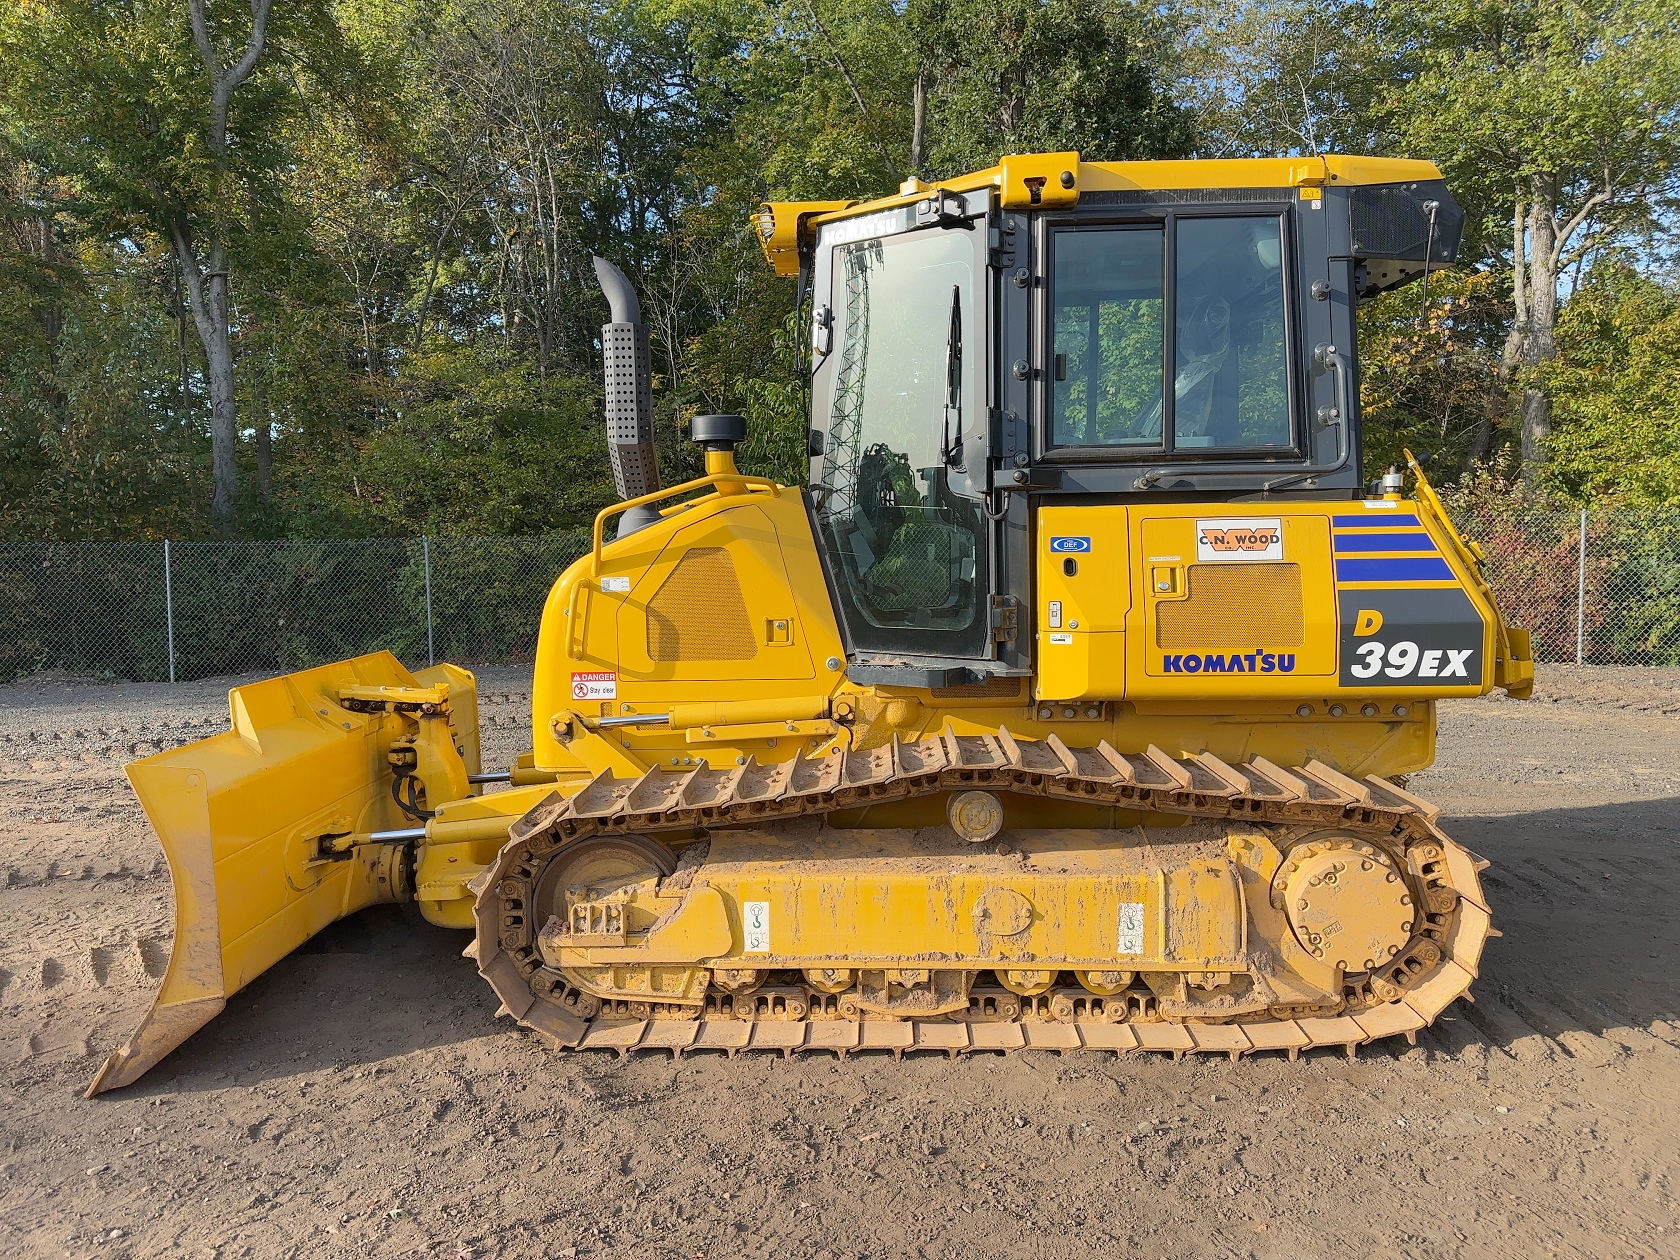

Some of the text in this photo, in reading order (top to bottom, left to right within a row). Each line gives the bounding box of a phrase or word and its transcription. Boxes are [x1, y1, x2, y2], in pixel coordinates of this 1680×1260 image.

[824, 217, 897, 246] KOMATSU
[1199, 534, 1280, 545] C.N. WOOD
[1353, 609, 1384, 637] D
[1163, 648, 1296, 673] KOMATSU
[581, 673, 616, 681] DANGER
[589, 686, 615, 695] Stay clear
